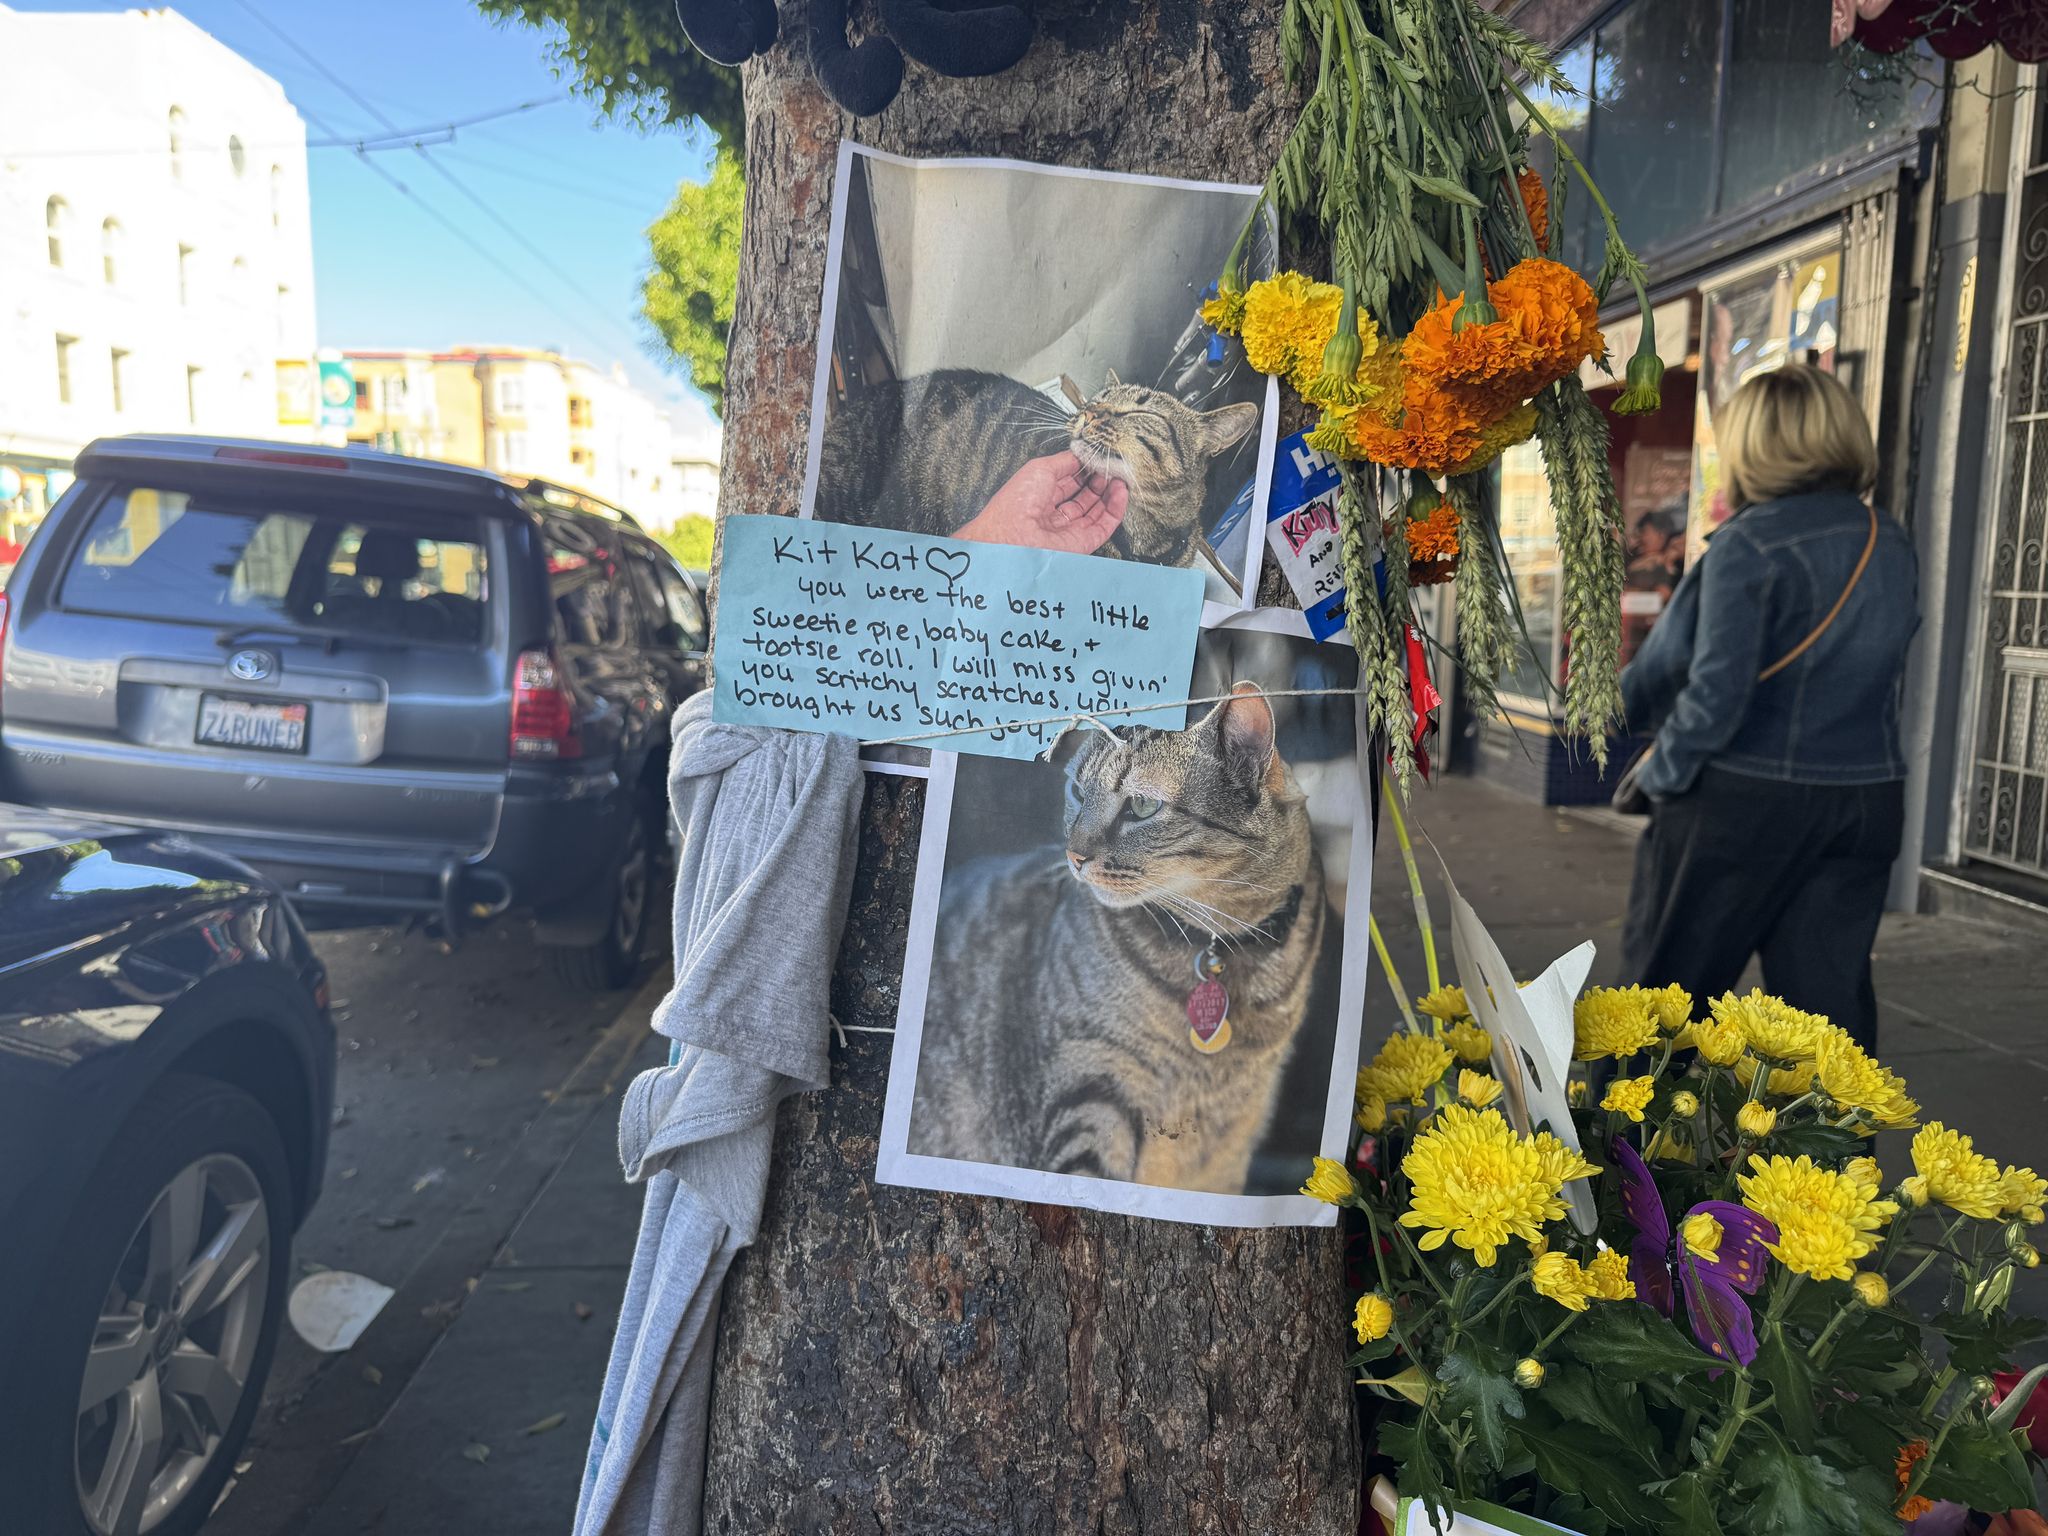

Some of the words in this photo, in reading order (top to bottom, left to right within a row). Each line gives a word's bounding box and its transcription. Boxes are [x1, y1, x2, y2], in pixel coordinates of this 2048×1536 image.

[774, 535, 838, 565] Kit
[851, 540, 920, 572] Kat
[798, 576, 847, 604] you
[866, 582, 929, 604] were
[936, 582, 988, 611] the
[1006, 589, 1066, 620] best
[1091, 599, 1150, 631] little
[752, 605, 859, 636] sweetie
[922, 617, 990, 657] baby
[999, 628, 1078, 659] cake,
[1084, 637, 1102, 652] +
[741, 659, 795, 687] you
[814, 665, 920, 710] scritchy
[936, 679, 1070, 712] scratches.
[1076, 691, 1132, 717] you
[742, 631, 842, 661] tootsie
[857, 646, 914, 671] roll.
[931, 646, 939, 669] I
[952, 655, 997, 679] will
[1012, 660, 1076, 684] miss
[1091, 668, 1168, 699] givin'
[733, 679, 856, 720] brought
[866, 699, 903, 723] us
[918, 704, 985, 731] such
